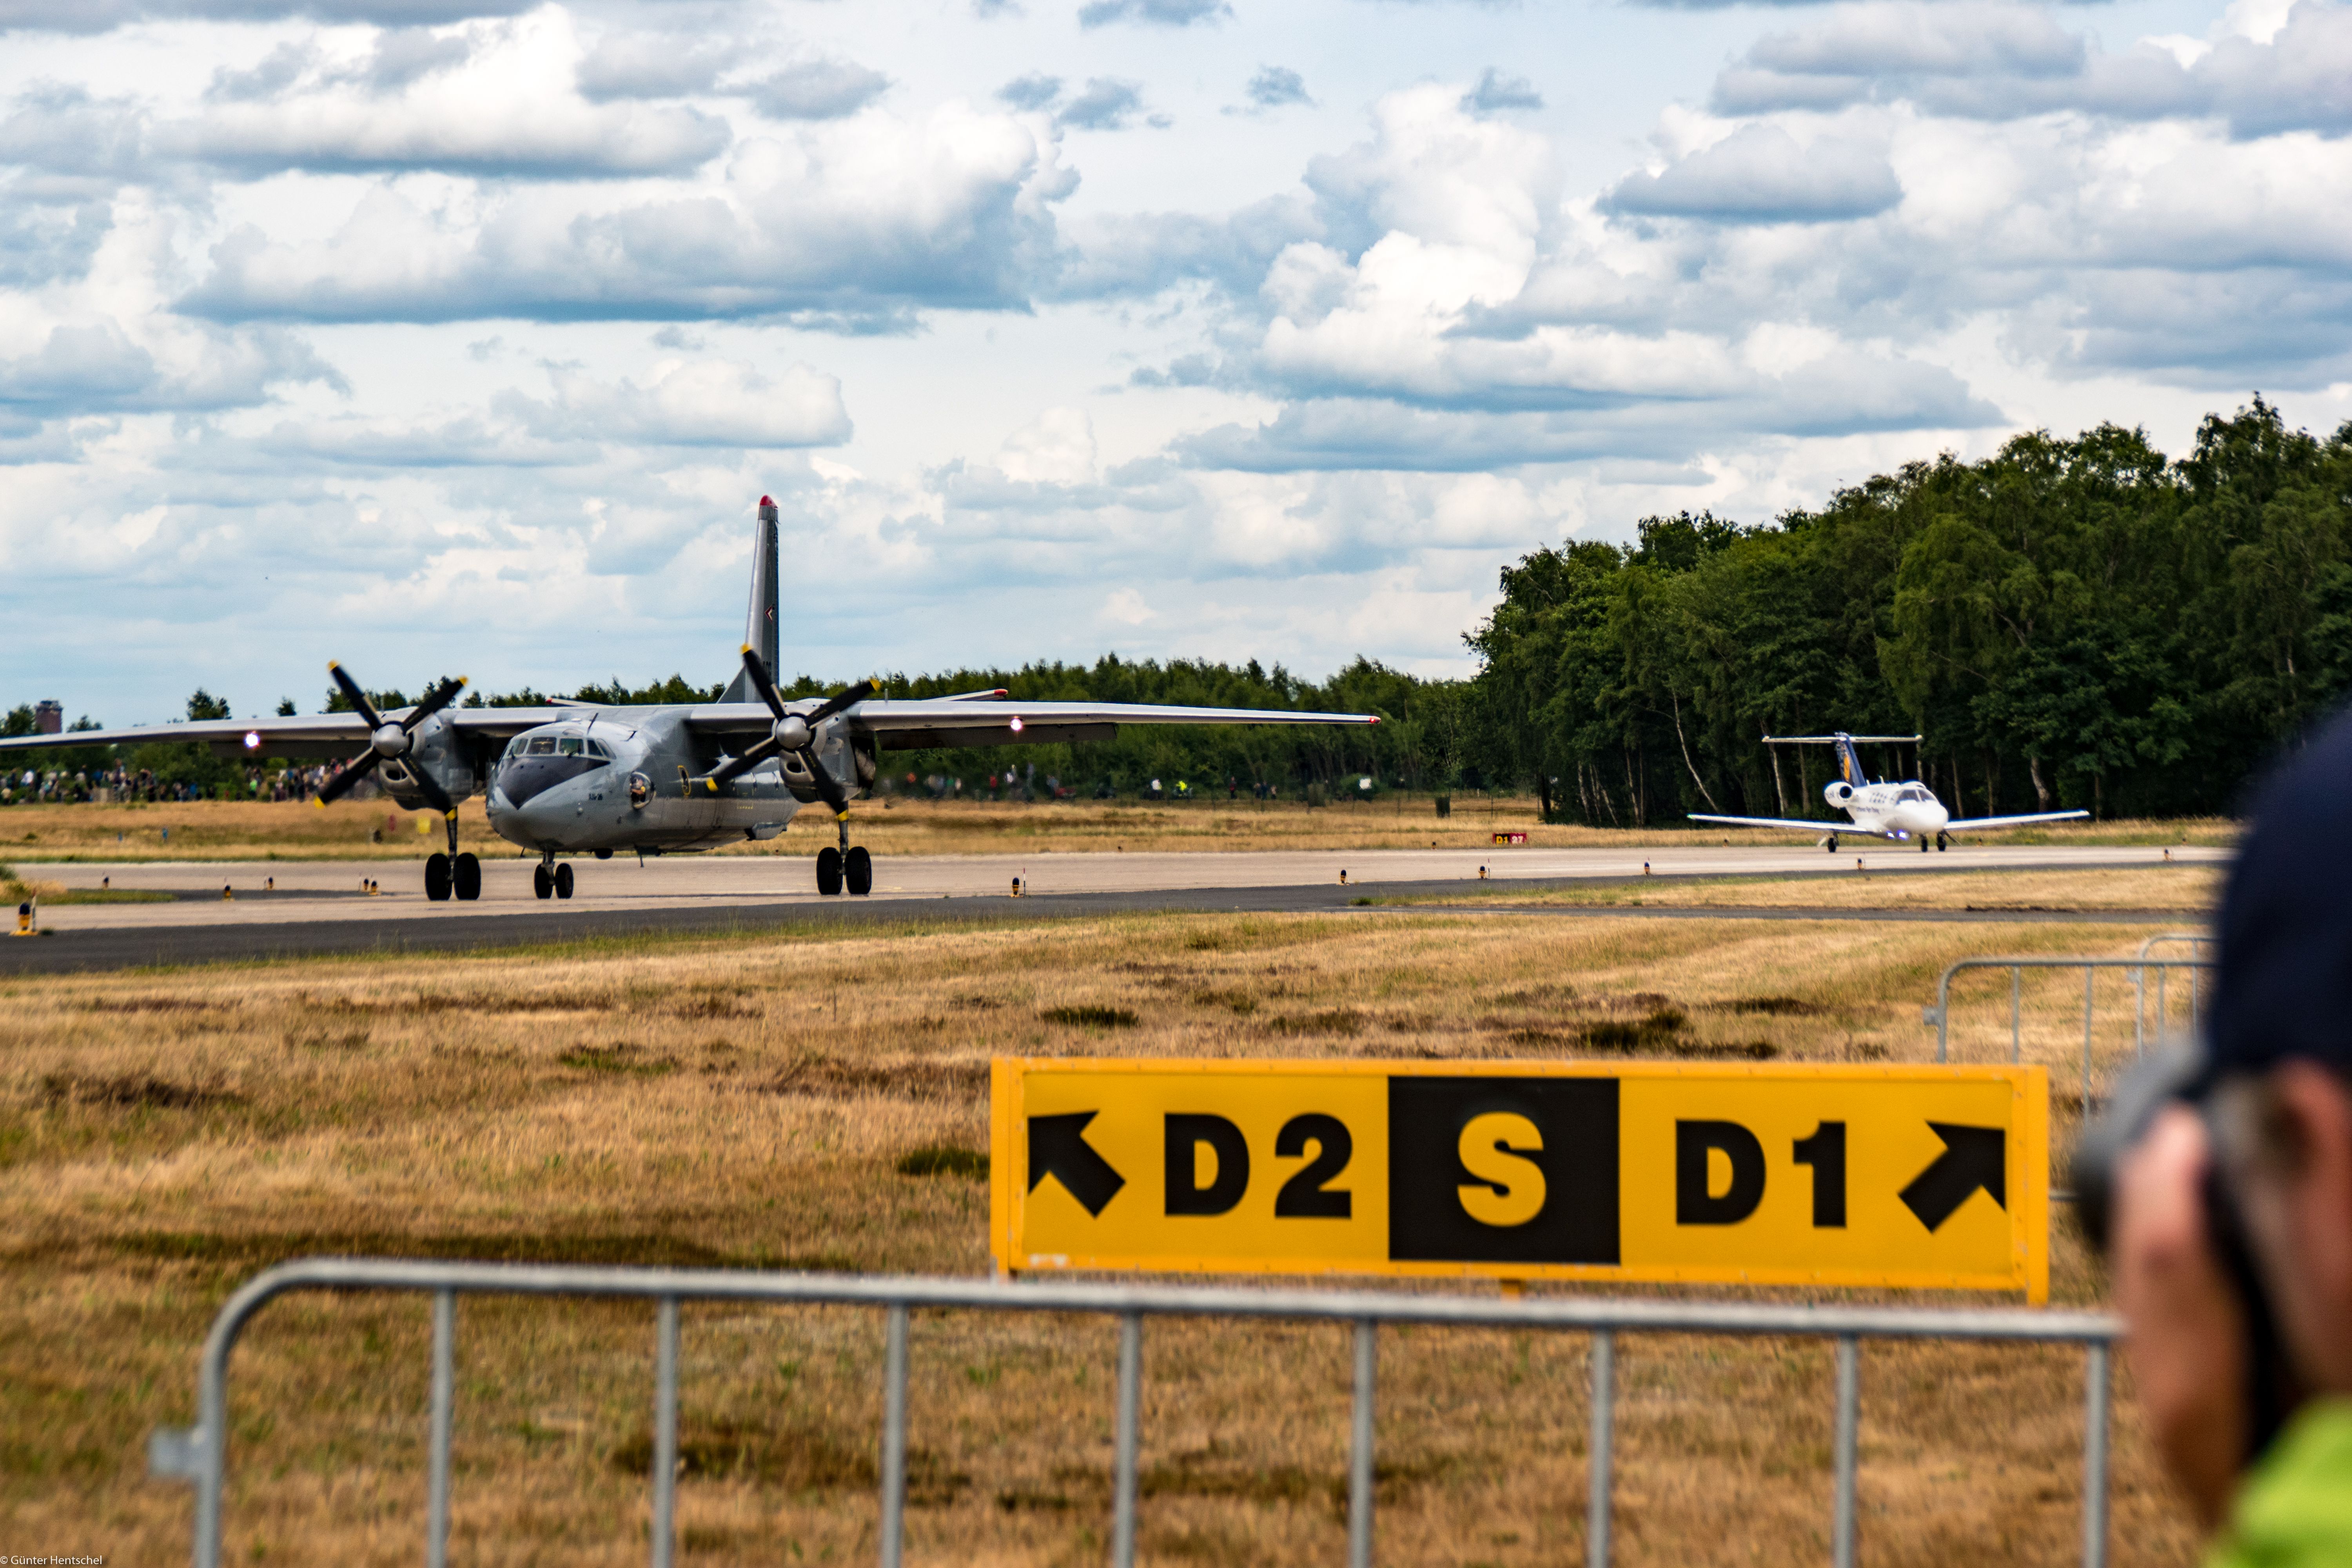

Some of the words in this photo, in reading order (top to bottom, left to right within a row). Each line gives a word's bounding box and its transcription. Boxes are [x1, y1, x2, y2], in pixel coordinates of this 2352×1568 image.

[1496, 836, 1508, 844] D1
[1163, 1112, 1354, 1220] D2
[1458, 1112, 1546, 1225] S
[1675, 1118, 1847, 1229] D1
